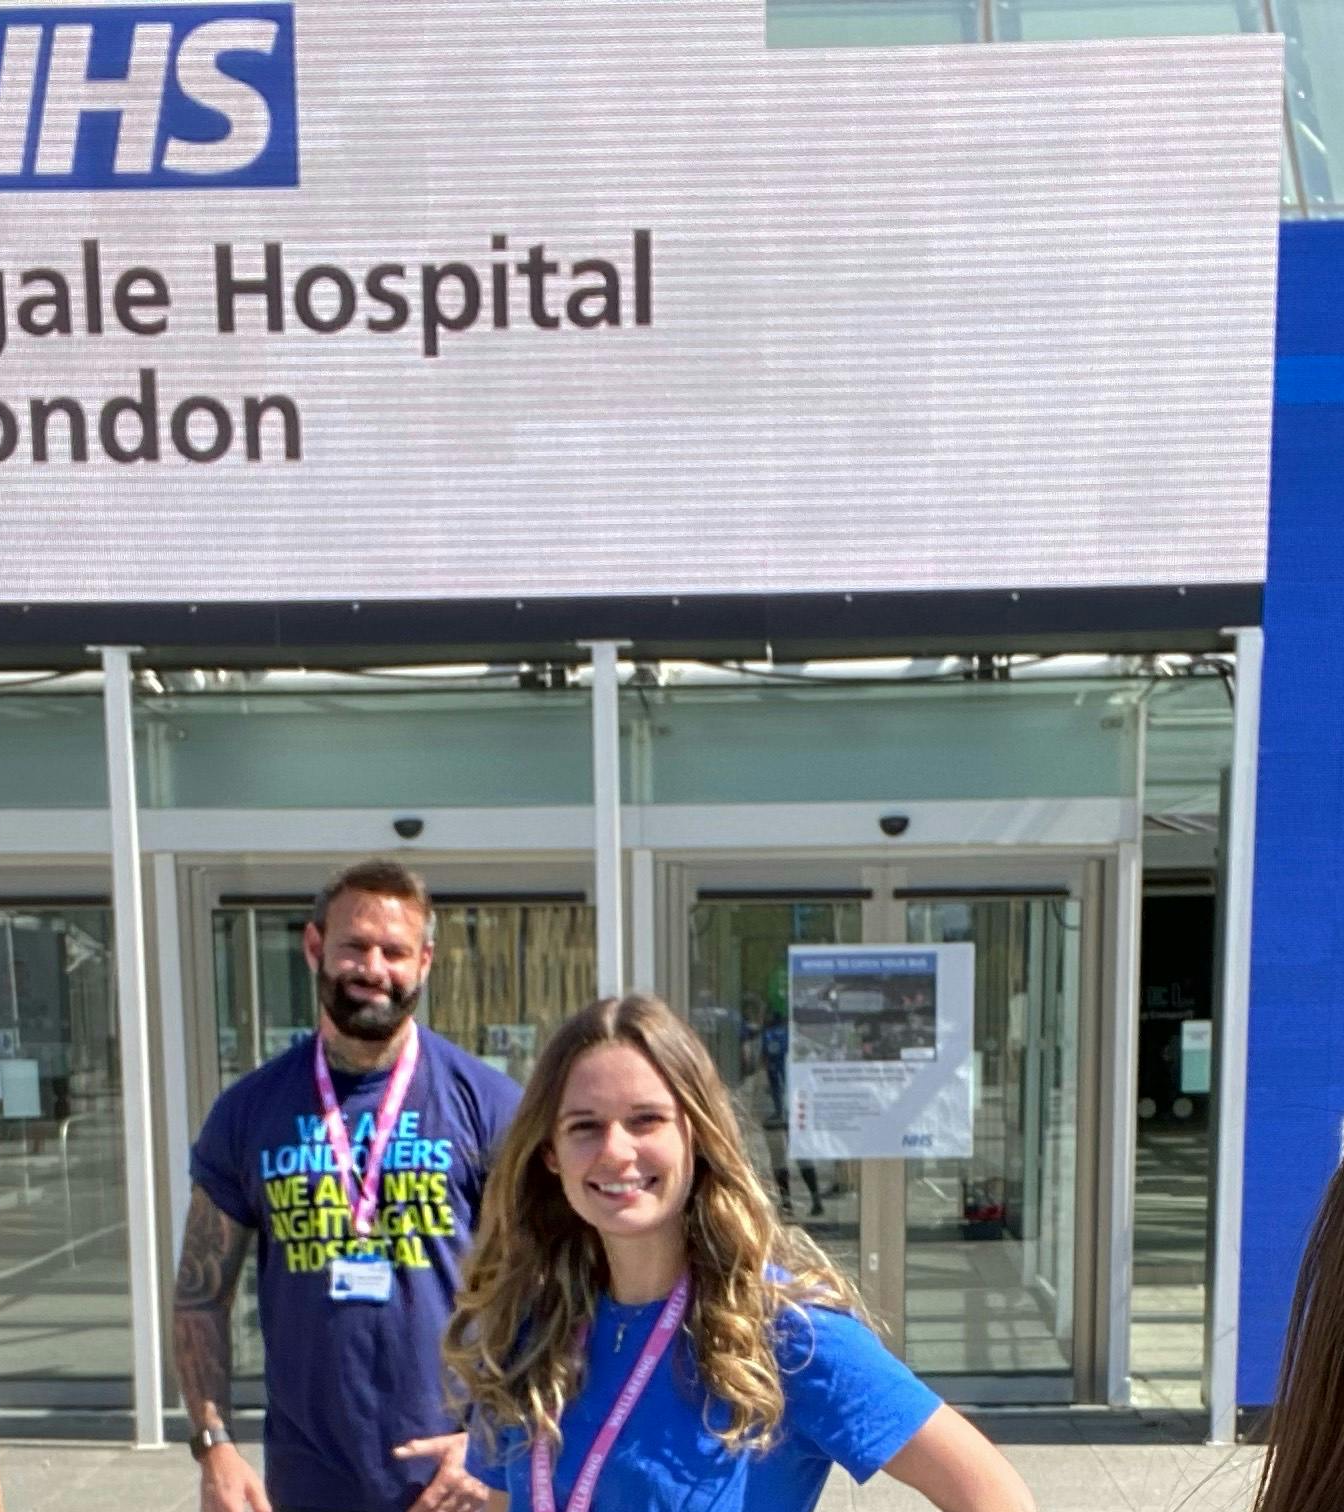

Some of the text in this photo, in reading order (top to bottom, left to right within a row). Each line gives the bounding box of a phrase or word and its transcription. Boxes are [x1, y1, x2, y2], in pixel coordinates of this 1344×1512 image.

[214, 230, 654, 356] Hospital
[353, 1111, 420, 1142] AE
[266, 1175, 310, 1210] WE
[384, 1170, 448, 1205] NHS
